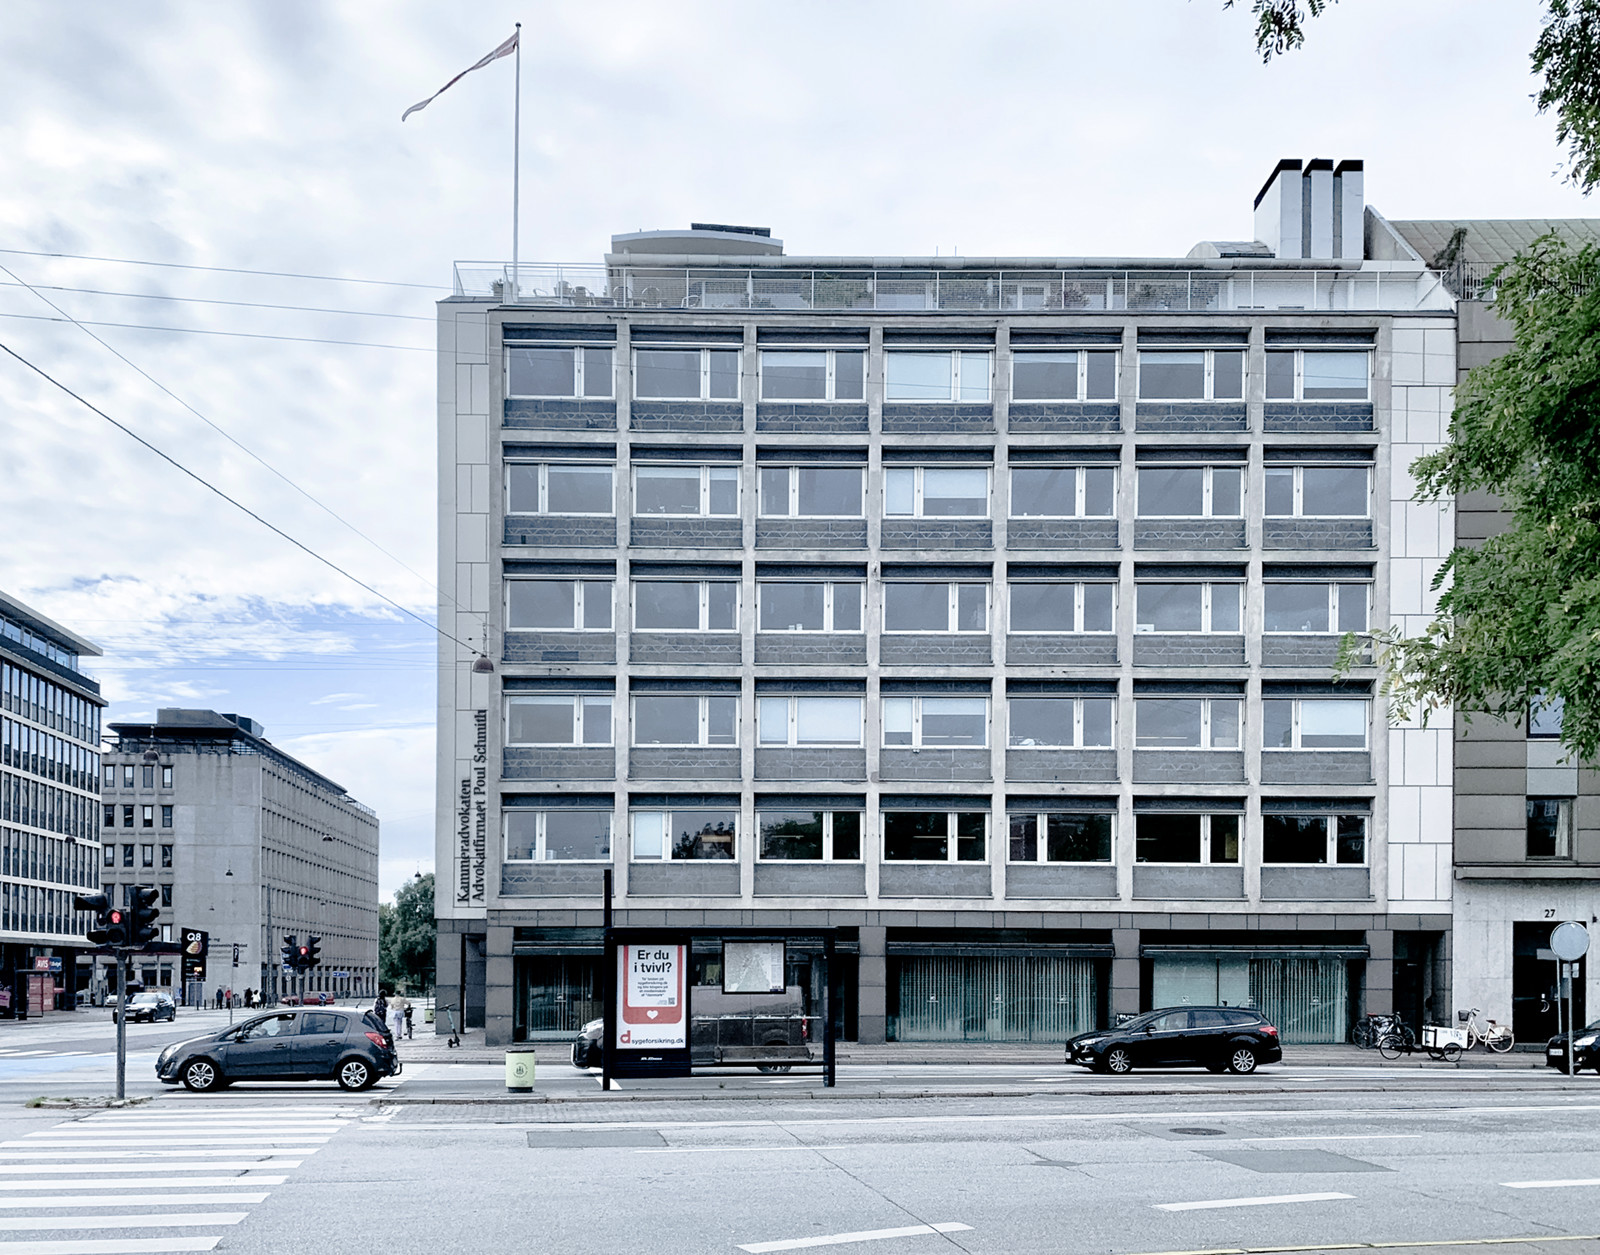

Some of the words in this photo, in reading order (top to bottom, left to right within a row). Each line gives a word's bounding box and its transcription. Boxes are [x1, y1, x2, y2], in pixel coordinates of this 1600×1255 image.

[473, 709, 487, 763] Schmith
[473, 767, 486, 795] Poul
[457, 779, 471, 902] Kammeradvokaten
[472, 800, 486, 902] Advokatfirmaet
[1544, 909, 1556, 918] 27
[187, 933, 202, 941] Q8
[637, 950, 651, 960] Er
[653, 950, 669, 960] du
[634, 962, 637, 973] i
[640, 962, 672, 973] tvivl?
[620, 1030, 631, 1044] d
